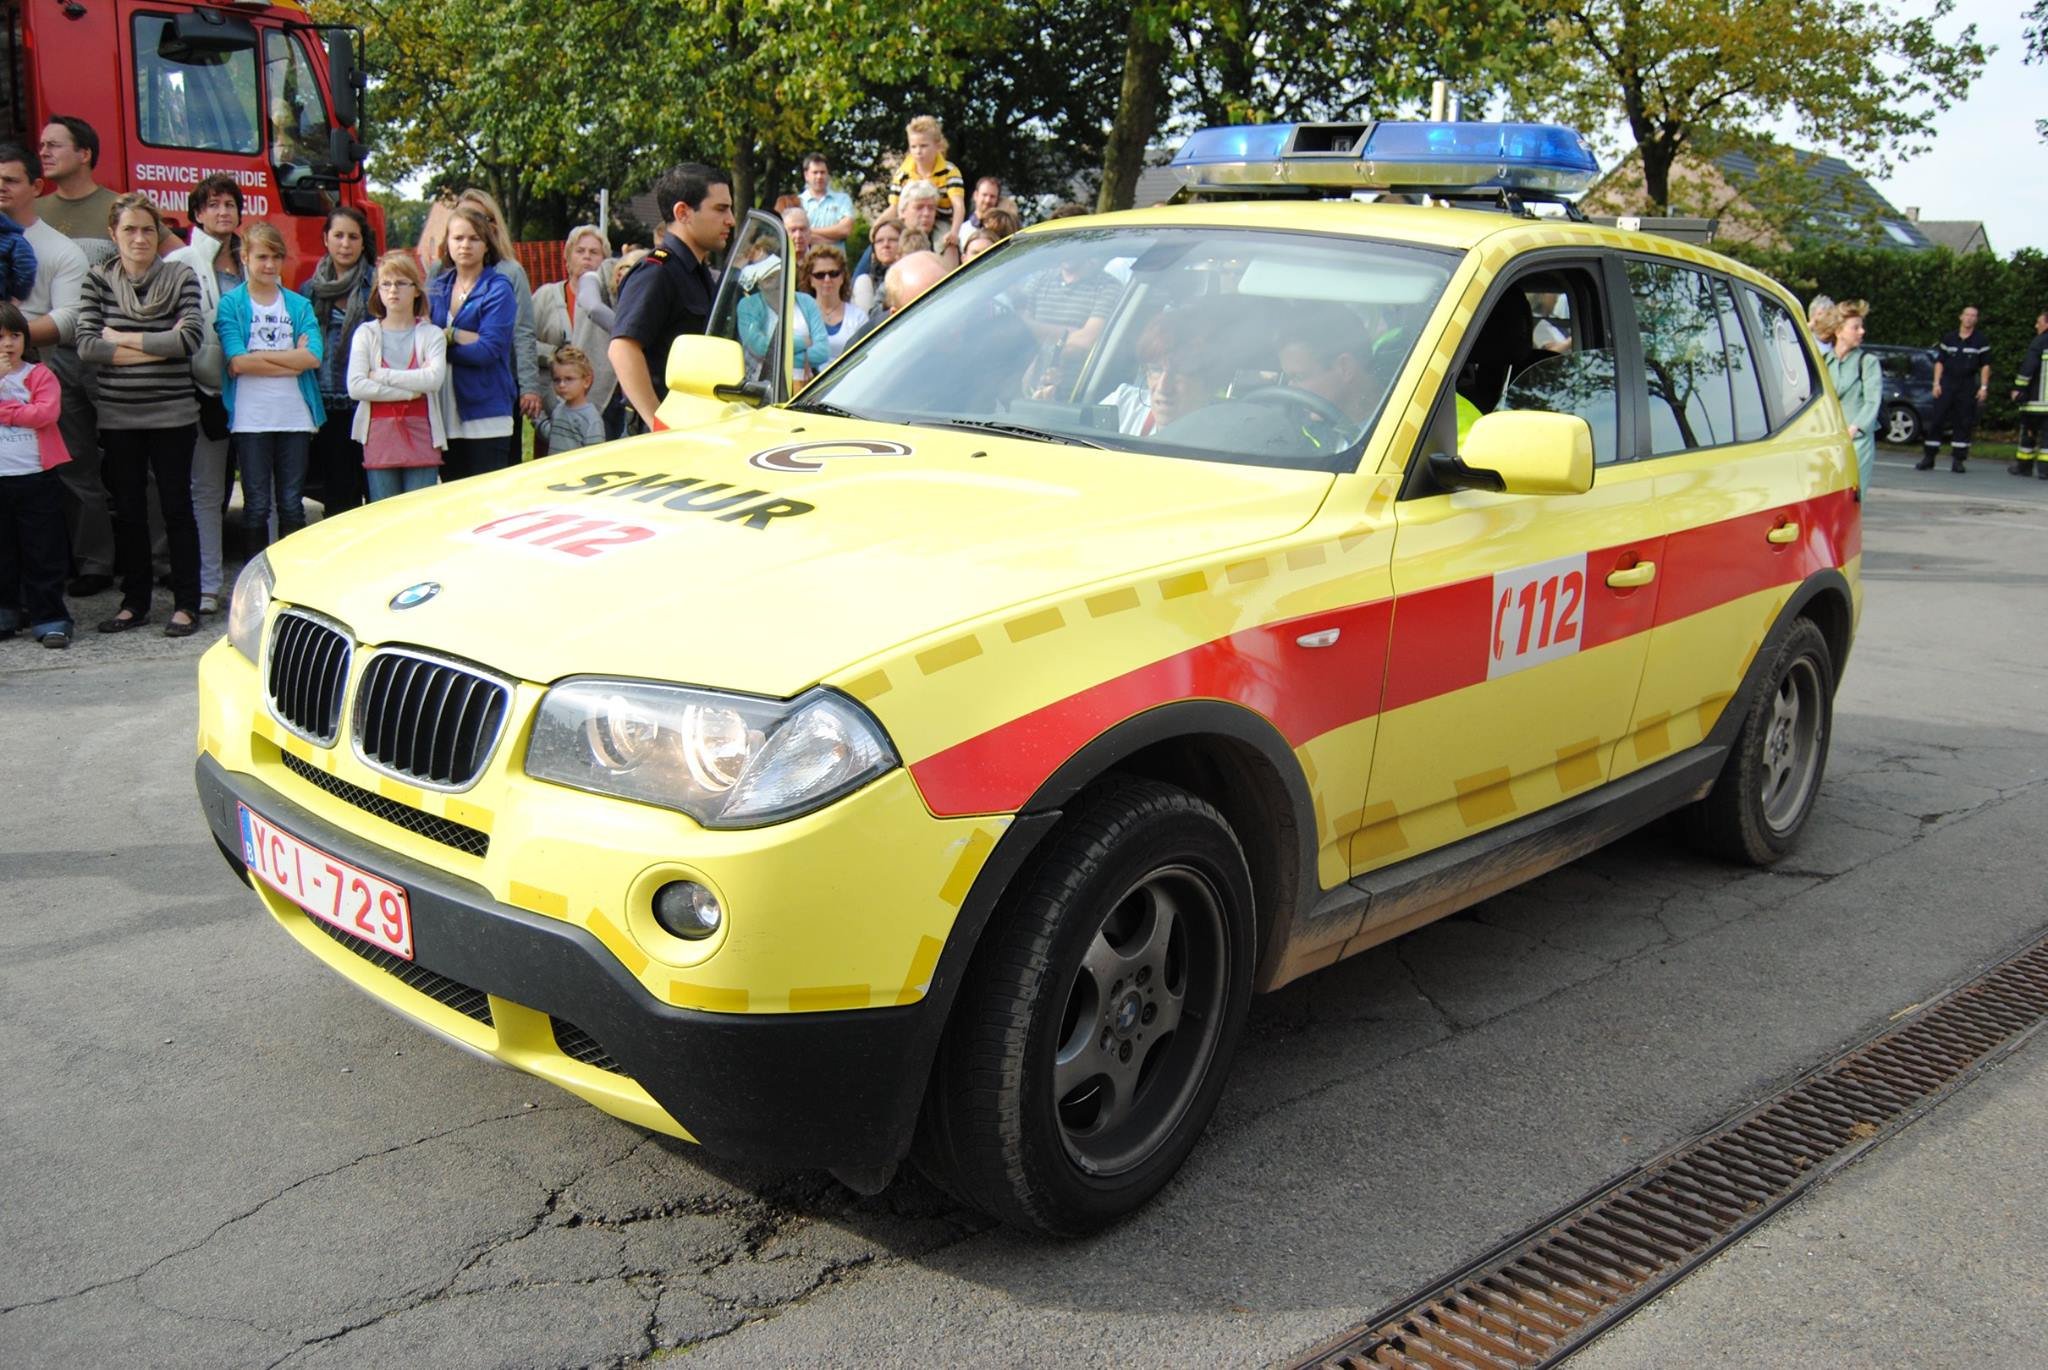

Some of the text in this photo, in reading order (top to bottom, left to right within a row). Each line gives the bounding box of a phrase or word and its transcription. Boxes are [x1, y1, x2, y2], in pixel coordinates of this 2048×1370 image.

[136, 163, 198, 183] SERVICE
[547, 471, 815, 530] SMUR
[497, 514, 657, 557] 112
[1516, 570, 1583, 656] 112
[253, 820, 404, 944] YCI-729
